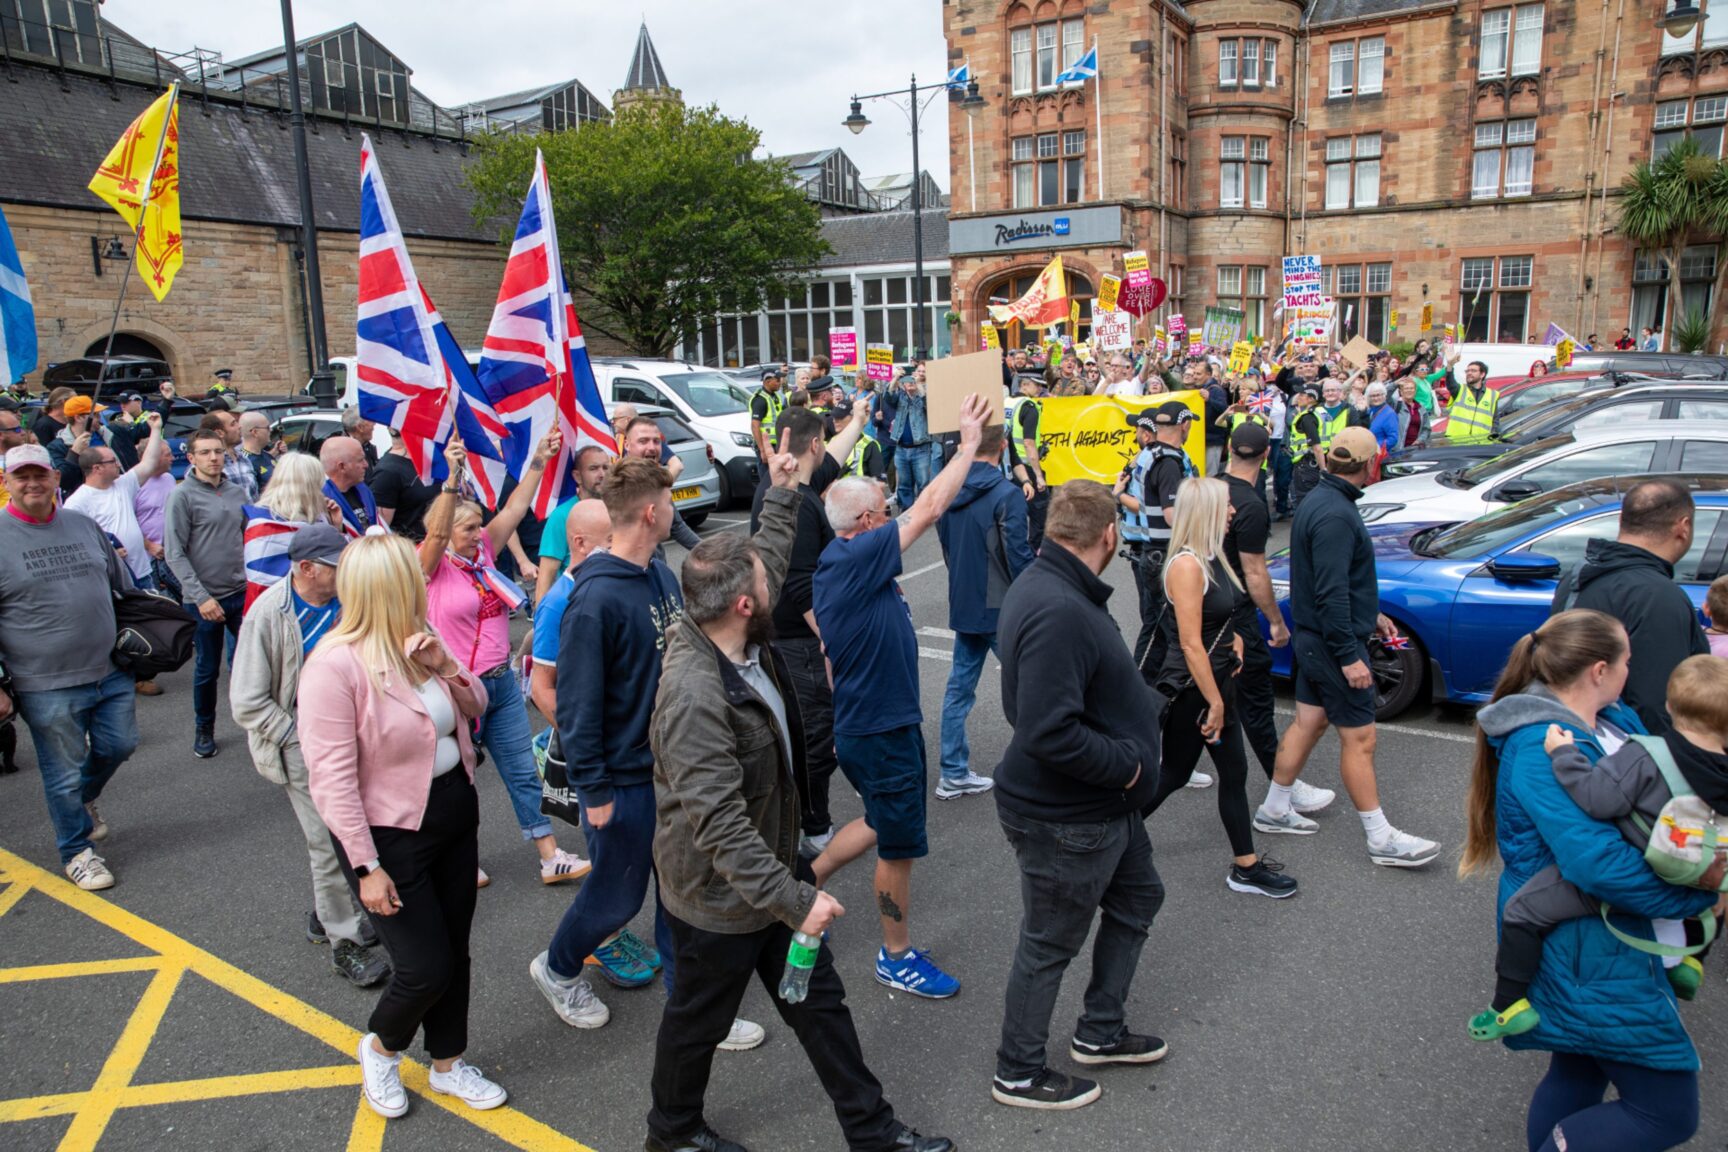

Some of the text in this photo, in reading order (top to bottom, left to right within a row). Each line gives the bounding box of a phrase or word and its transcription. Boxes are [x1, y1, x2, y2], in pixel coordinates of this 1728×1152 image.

[995, 219, 1054, 247] Radisson
[1284, 256, 1314, 267] NEVER
[1284, 265, 1321, 274] MIND THE
[1285, 272, 1321, 282] DINGHIES
[1285, 284, 1320, 294] STOP THE
[1285, 293, 1321, 307] YACHTS
[1104, 314, 1117, 324] ARE
[1095, 322, 1127, 336] WELCOME
[1104, 334, 1120, 345] HERE
[1074, 429, 1132, 448] AGAINST
[25, 559, 47, 571] AND
[48, 553, 77, 567] FITCH
